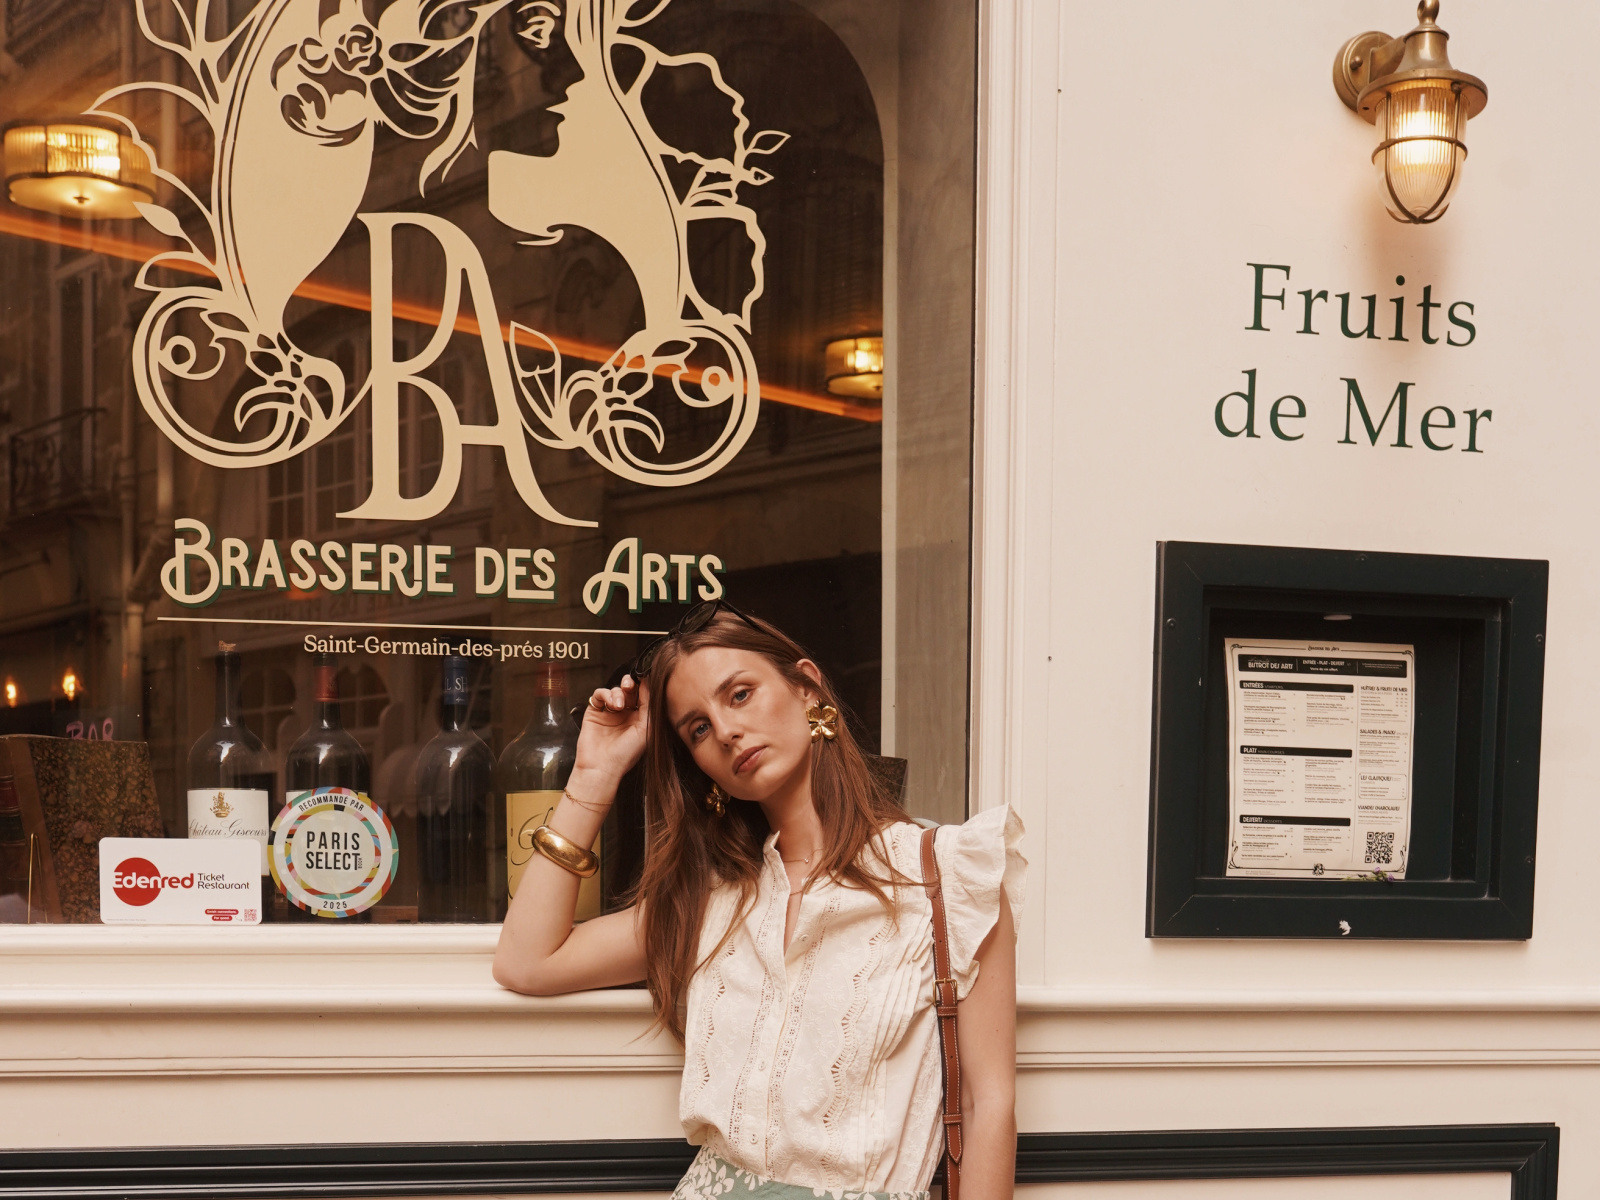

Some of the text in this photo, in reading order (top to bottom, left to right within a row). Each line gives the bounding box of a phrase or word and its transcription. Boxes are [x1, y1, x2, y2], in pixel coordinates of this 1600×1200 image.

[1244, 262, 1477, 347] Fruits
[1214, 368, 1493, 454] de Mer
[160, 518, 726, 617] BRASSERIE DES ARTS
[303, 634, 590, 662] Saint-Germain-des-prés 1901
[298, 795, 365, 812] RECOMMANDÉ PAR
[306, 831, 360, 851] PARIS
[305, 851, 361, 871] SELECT
[112, 871, 195, 889] Edenred
[197, 872, 225, 882] Ticket
[197, 881, 250, 890] Restaurant
[323, 900, 348, 910] 2025
